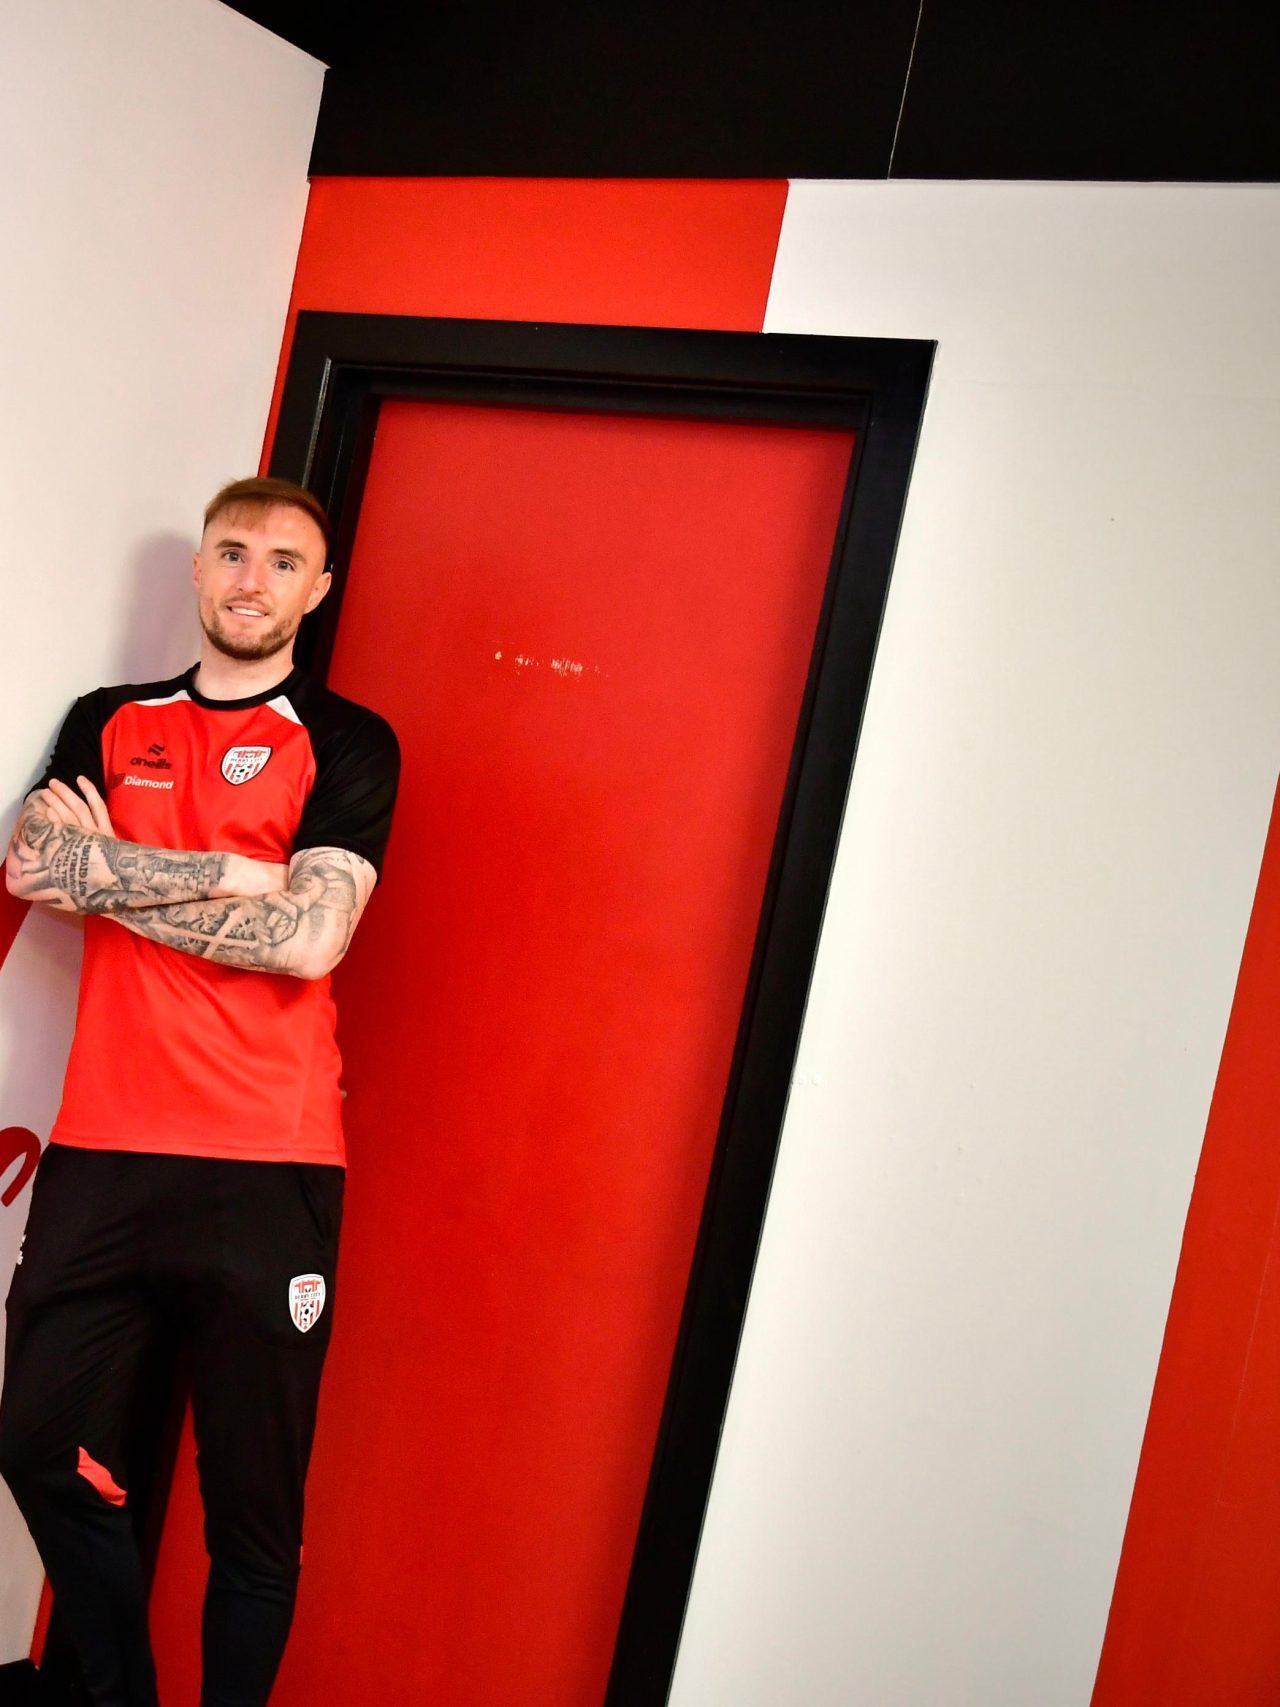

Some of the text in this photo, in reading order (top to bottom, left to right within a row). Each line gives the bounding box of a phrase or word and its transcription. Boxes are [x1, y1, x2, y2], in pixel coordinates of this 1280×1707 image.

[124, 775, 174, 790] Diamond
[69, 851, 78, 894] YOURSELF
[79, 844, 91, 878] GIVING
